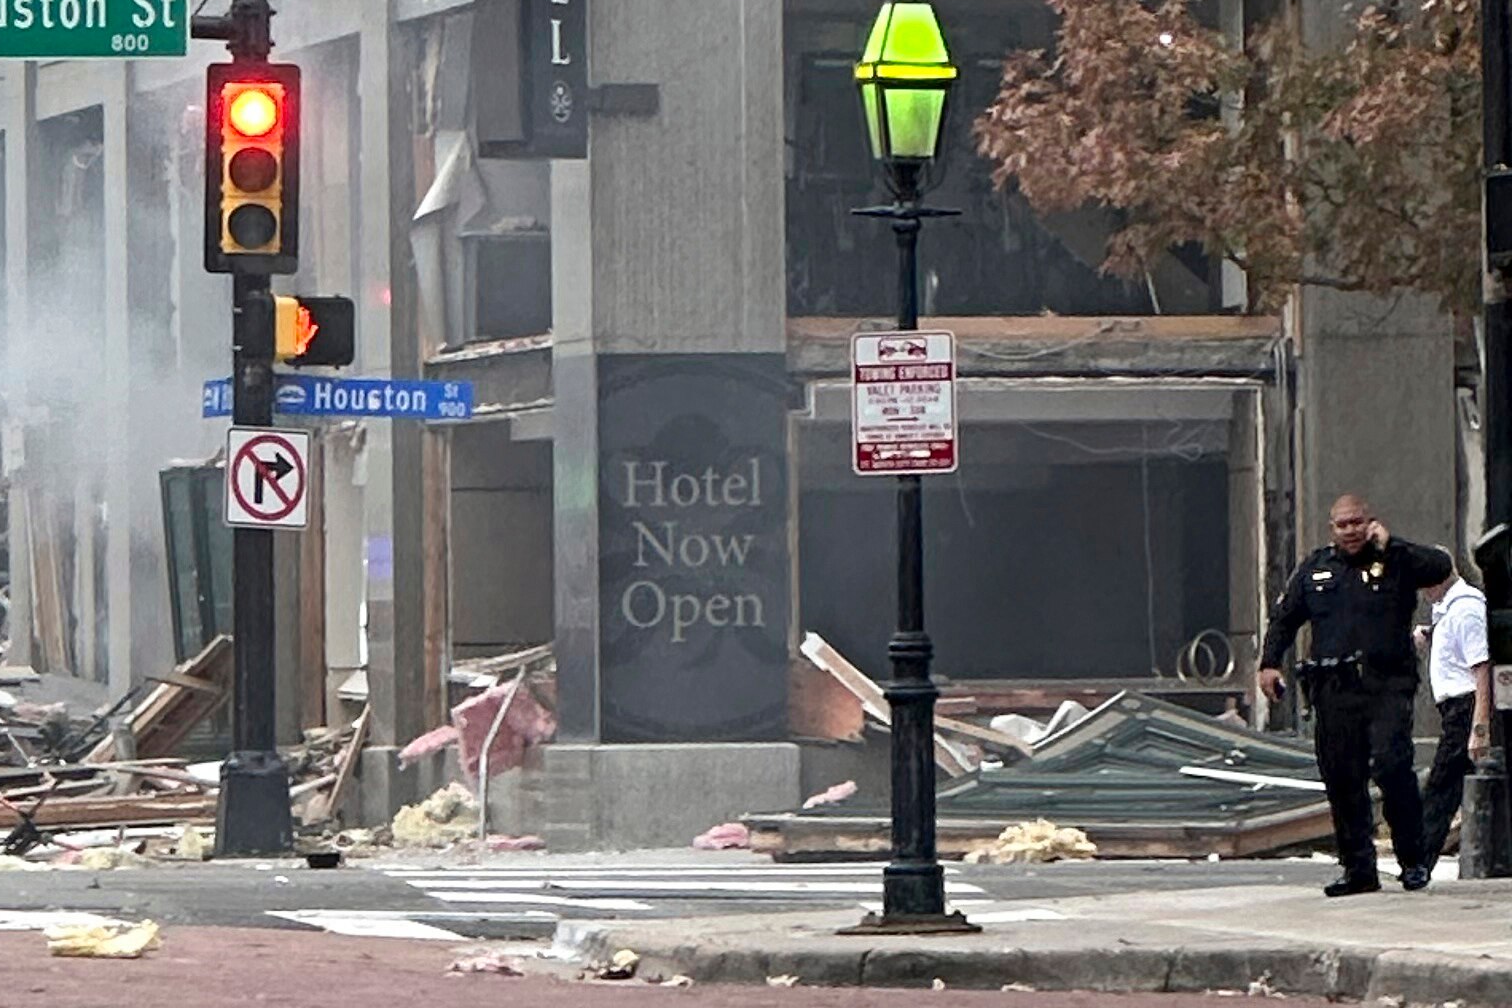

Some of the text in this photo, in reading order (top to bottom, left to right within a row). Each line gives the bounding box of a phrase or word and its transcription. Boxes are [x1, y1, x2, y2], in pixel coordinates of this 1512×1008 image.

[111, 34, 149, 52] 800
[314, 382, 427, 412] Houston
[621, 458, 762, 508] Hotel
[632, 521, 754, 568] Now
[621, 580, 766, 643] Open
